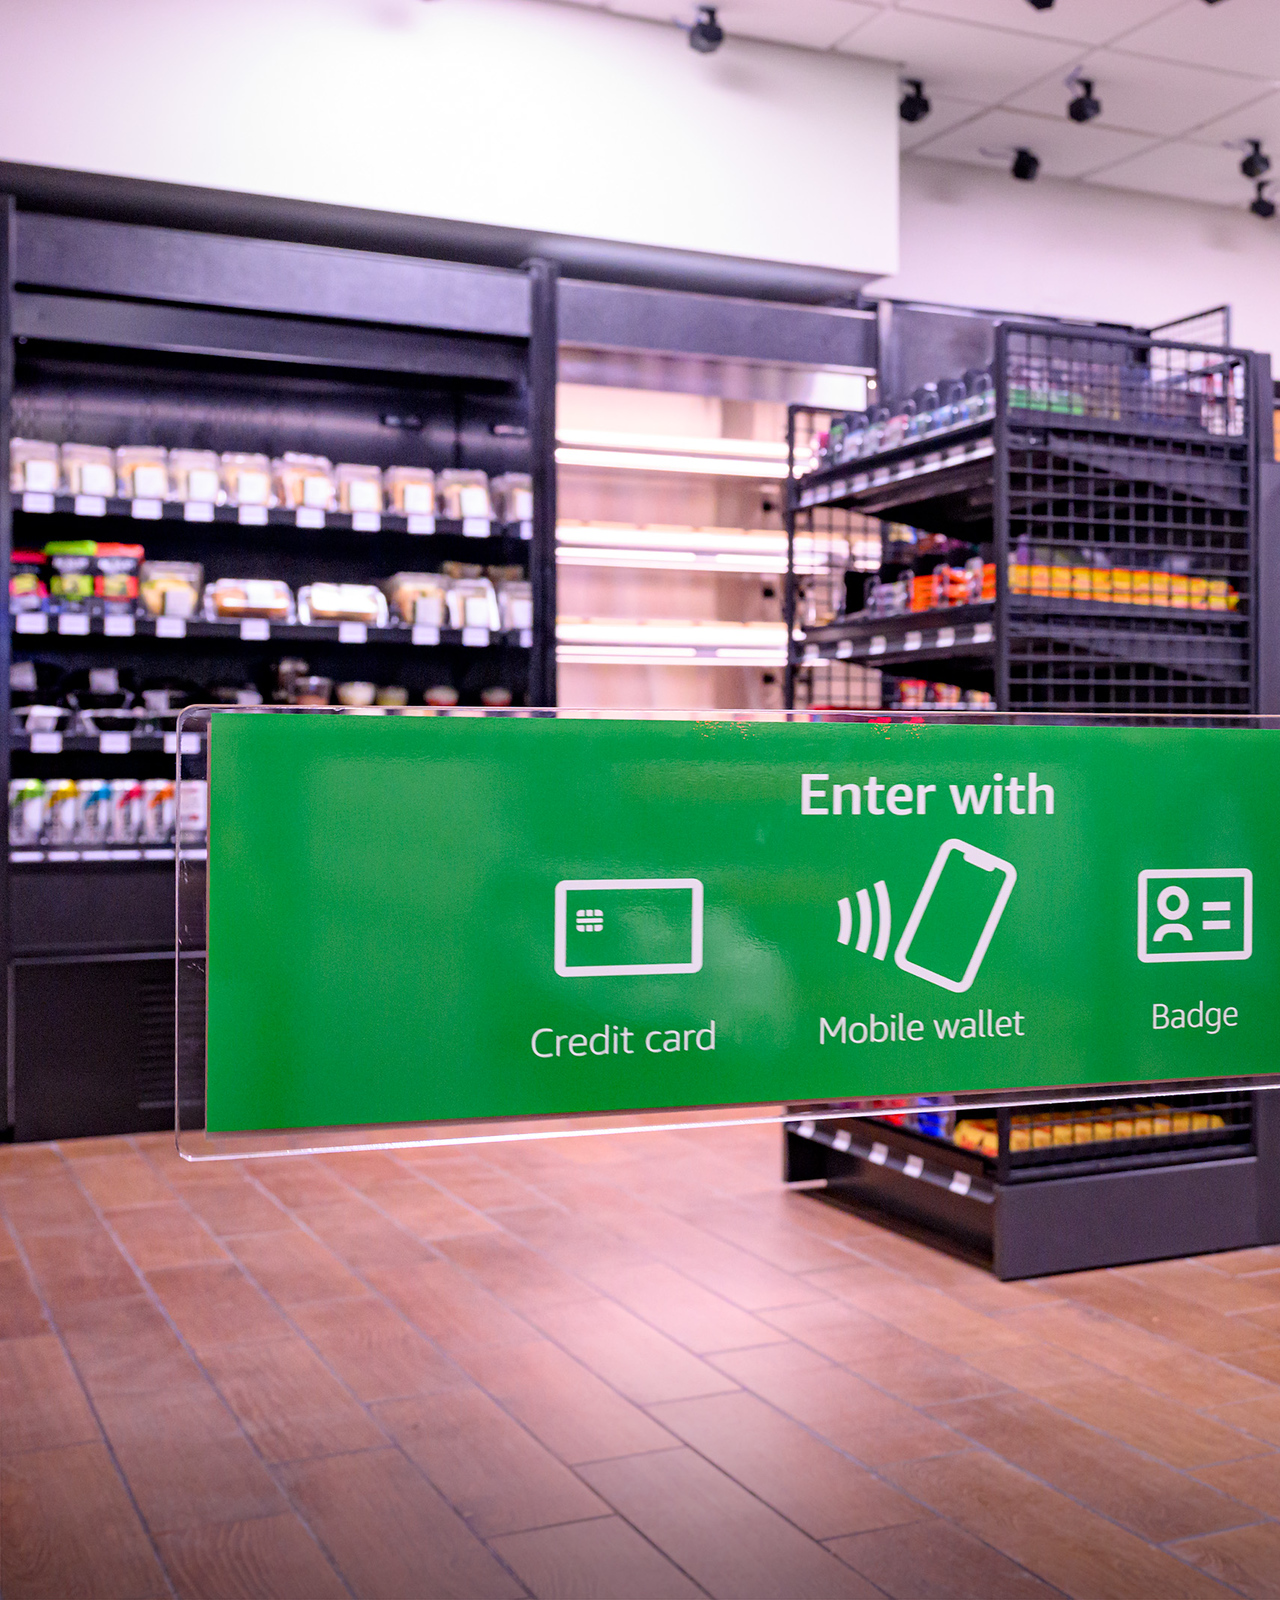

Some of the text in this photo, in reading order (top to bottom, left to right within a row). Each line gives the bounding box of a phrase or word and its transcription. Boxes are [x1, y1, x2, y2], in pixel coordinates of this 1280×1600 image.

[801, 772, 1055, 816] Enter with
[818, 1008, 1025, 1045] Mobile wallet
[1152, 998, 1238, 1035] Badge
[531, 1020, 716, 1059] Credit card
